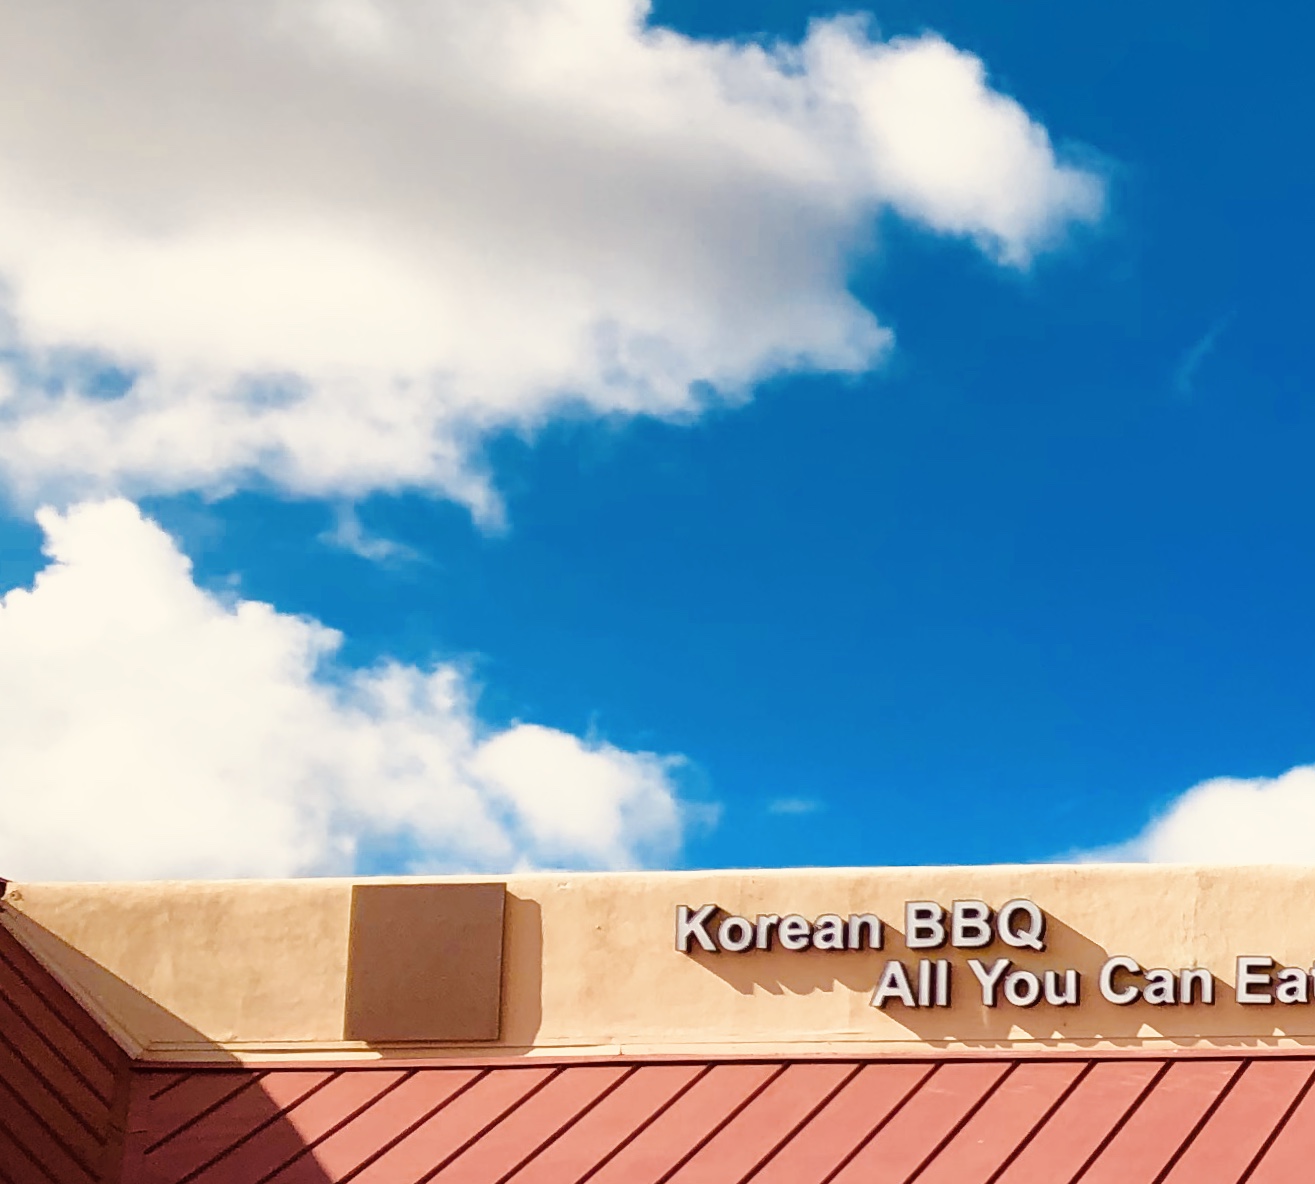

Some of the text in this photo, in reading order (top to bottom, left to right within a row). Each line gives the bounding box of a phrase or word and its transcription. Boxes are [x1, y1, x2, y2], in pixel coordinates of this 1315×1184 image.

[675, 899, 1047, 952] Korean BBQ
[872, 959, 949, 1008] All
[968, 959, 1079, 1008] You
[1100, 955, 1214, 1006] Can
